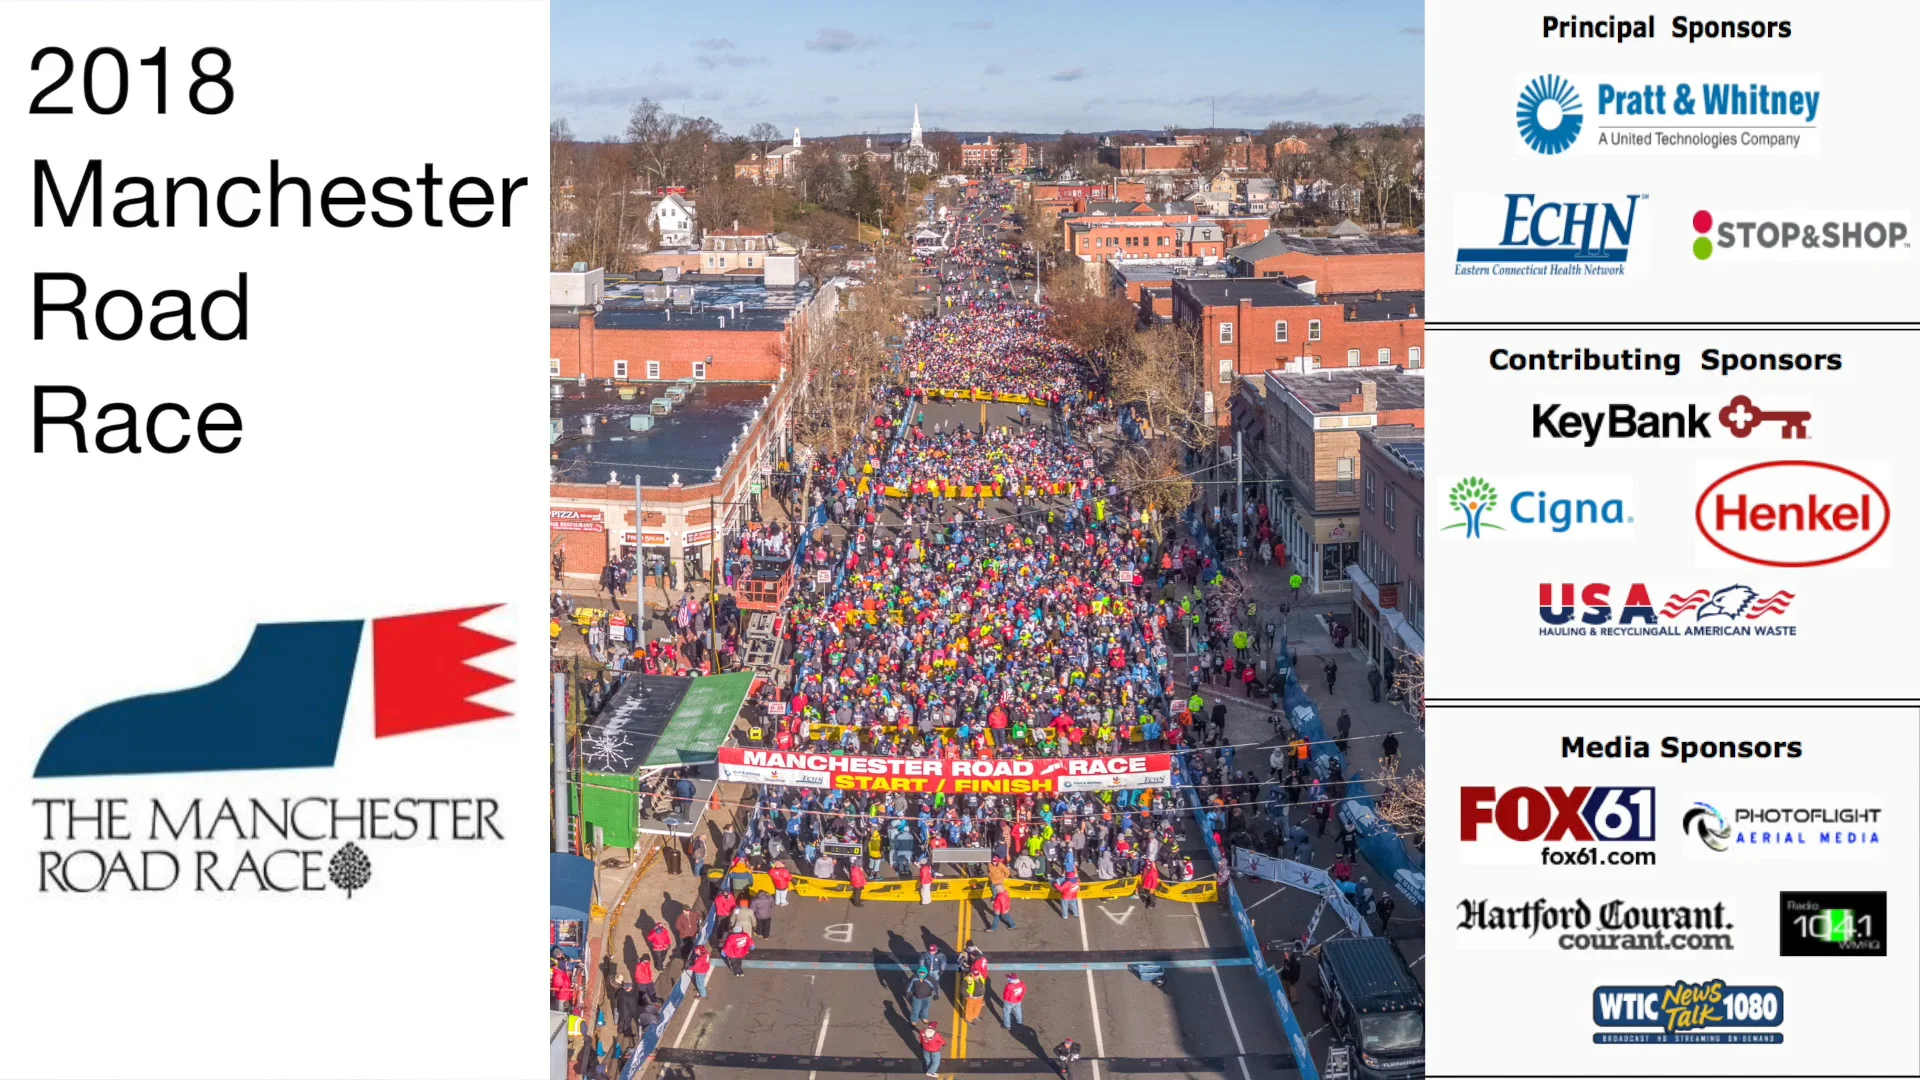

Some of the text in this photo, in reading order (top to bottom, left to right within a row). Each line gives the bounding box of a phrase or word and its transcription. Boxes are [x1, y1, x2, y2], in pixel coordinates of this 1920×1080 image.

[552, 510, 580, 518] PIZZA
[743, 750, 1147, 777] MANCHESTER ROAD RACE
[835, 774, 930, 792] START
[955, 779, 1053, 793] FINISH
